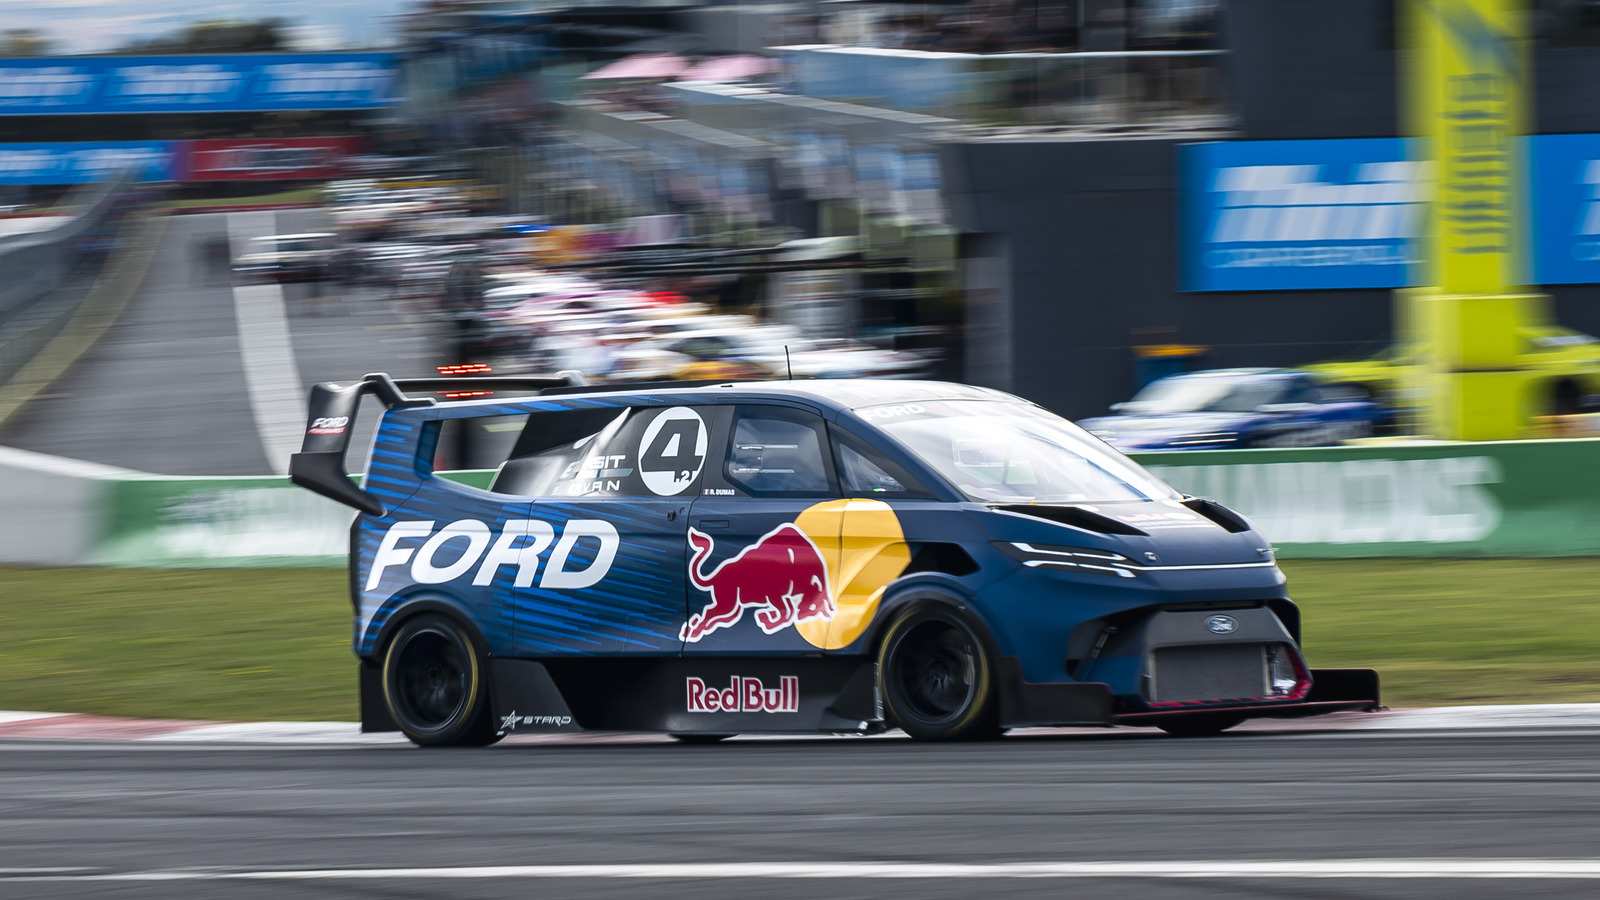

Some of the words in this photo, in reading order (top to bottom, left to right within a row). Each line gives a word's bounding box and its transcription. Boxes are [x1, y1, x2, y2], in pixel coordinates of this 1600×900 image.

[311, 416, 349, 428] FORD
[365, 518, 620, 592] FORD
[686, 676, 740, 712] Red
[741, 676, 799, 713] Bull
[523, 715, 572, 727] STARD
